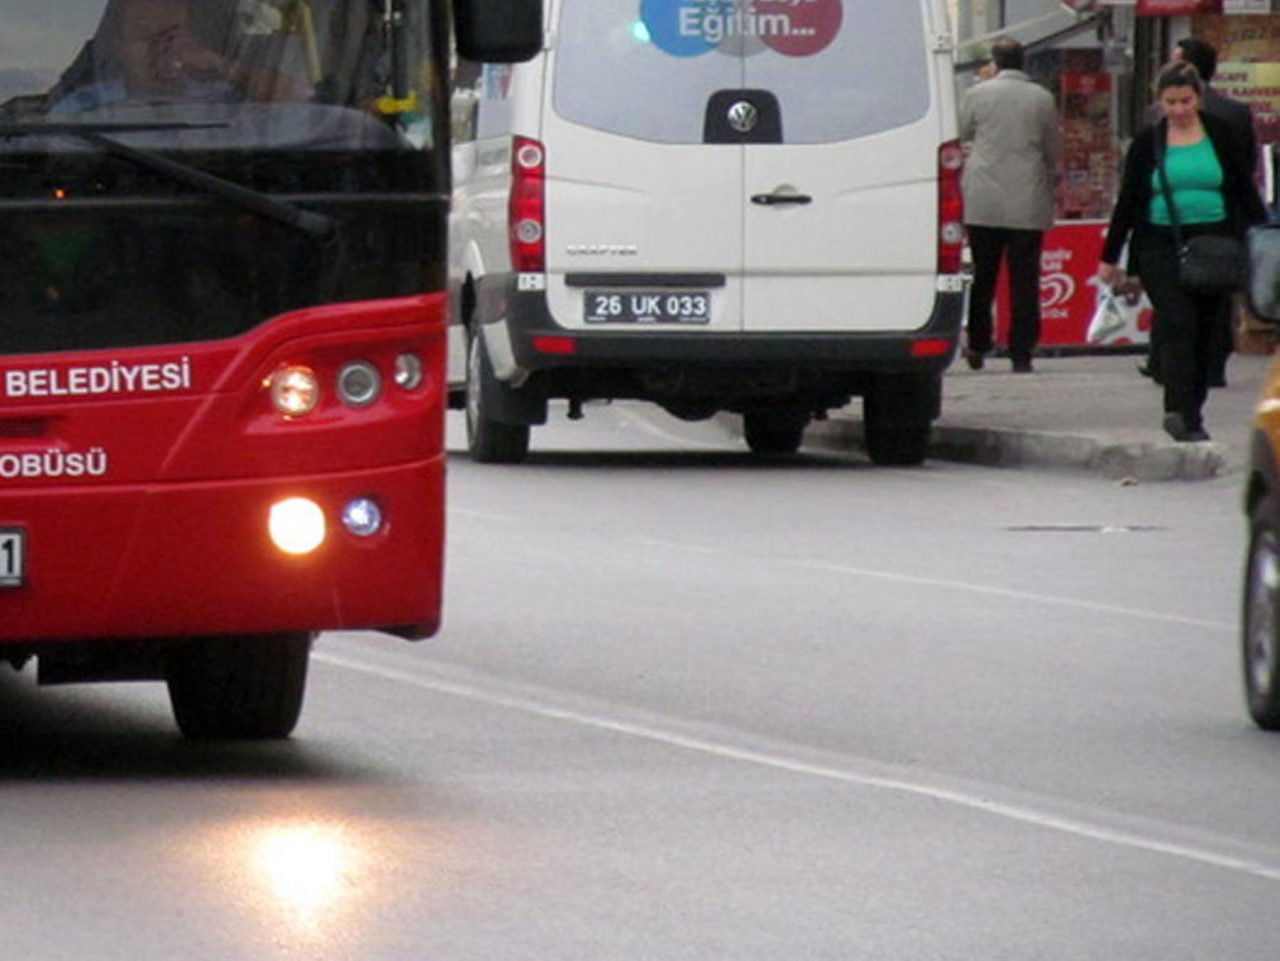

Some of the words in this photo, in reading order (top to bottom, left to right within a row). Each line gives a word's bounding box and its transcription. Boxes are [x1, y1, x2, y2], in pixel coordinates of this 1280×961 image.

[594, 295, 622, 316] 26
[631, 295, 661, 316] UK
[666, 295, 706, 316] 033
[5, 357, 191, 397] BELEDİYESİ
